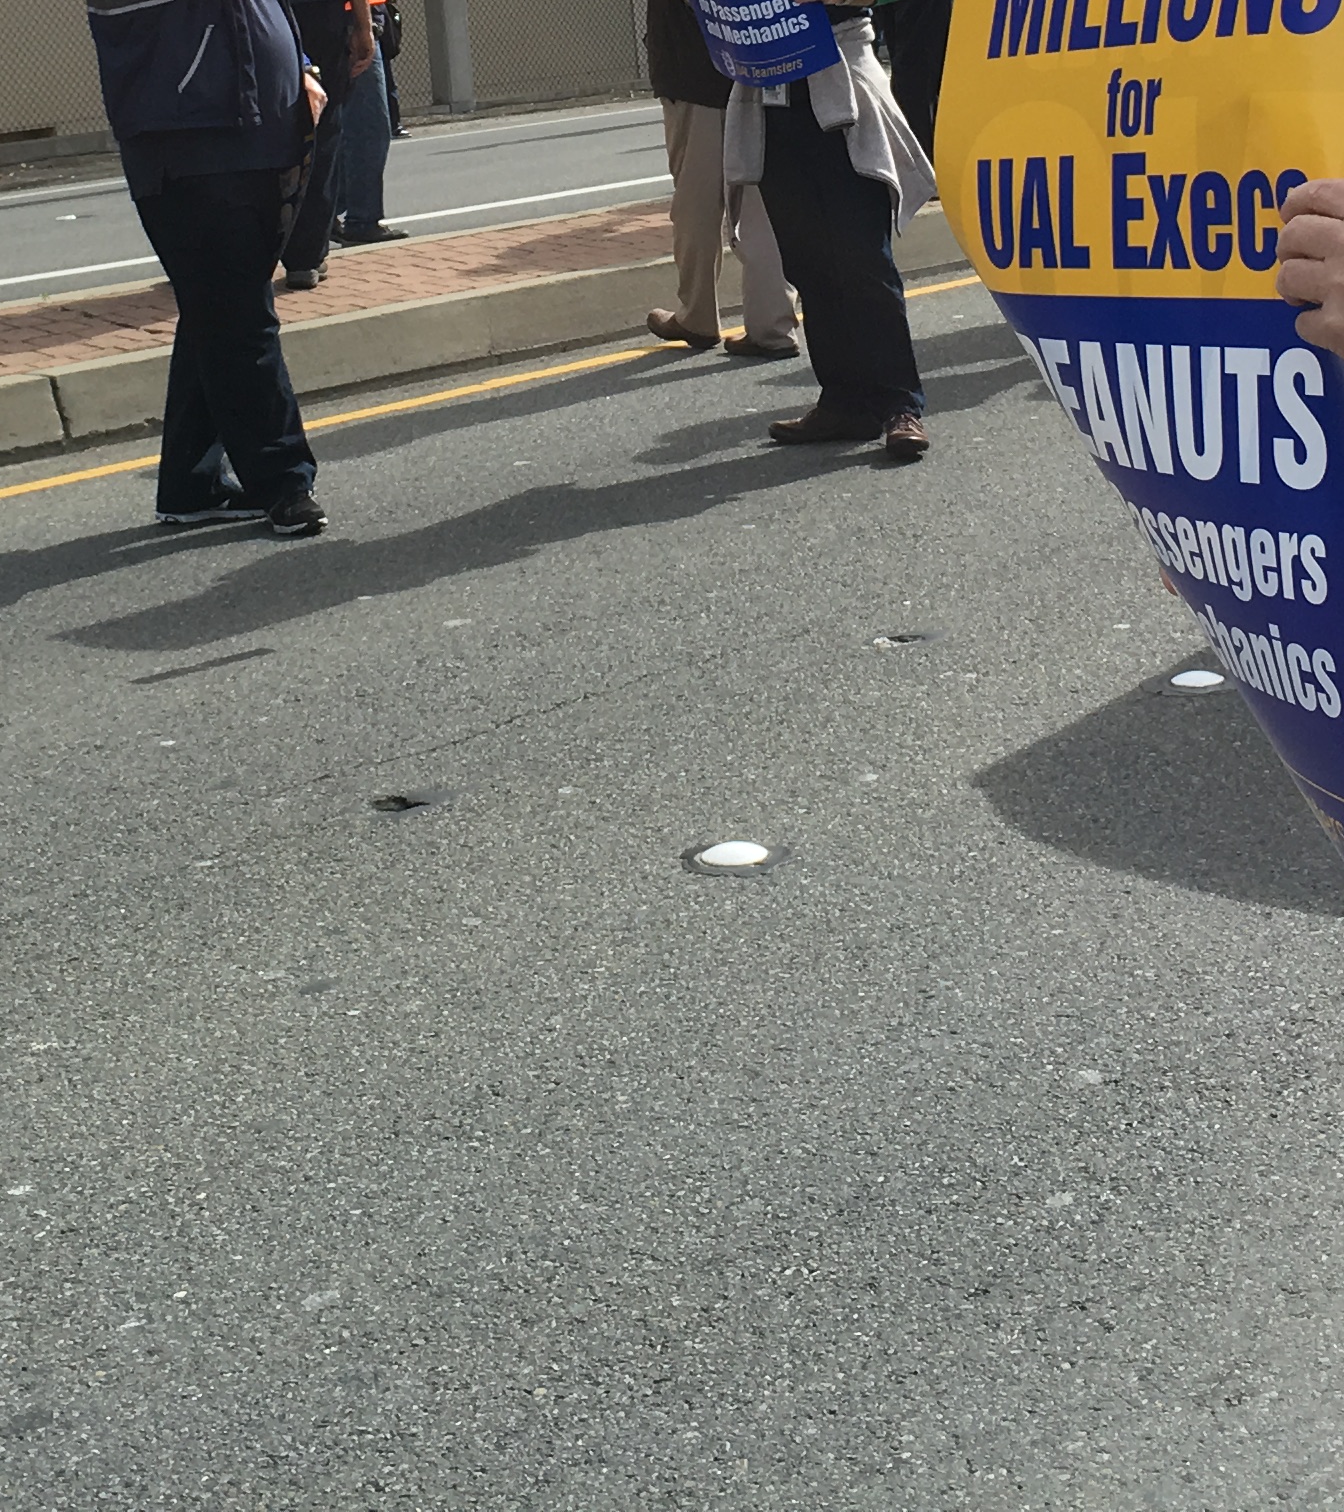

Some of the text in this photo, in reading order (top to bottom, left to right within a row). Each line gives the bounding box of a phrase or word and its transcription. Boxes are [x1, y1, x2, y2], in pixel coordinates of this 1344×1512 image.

[721, 13, 810, 45] Mechanics
[751, 58, 804, 78] Teamsters
[1106, 68, 1162, 138] for
[977, 155, 1090, 270] UAL
[1015, 332, 1327, 490] EANUTS
